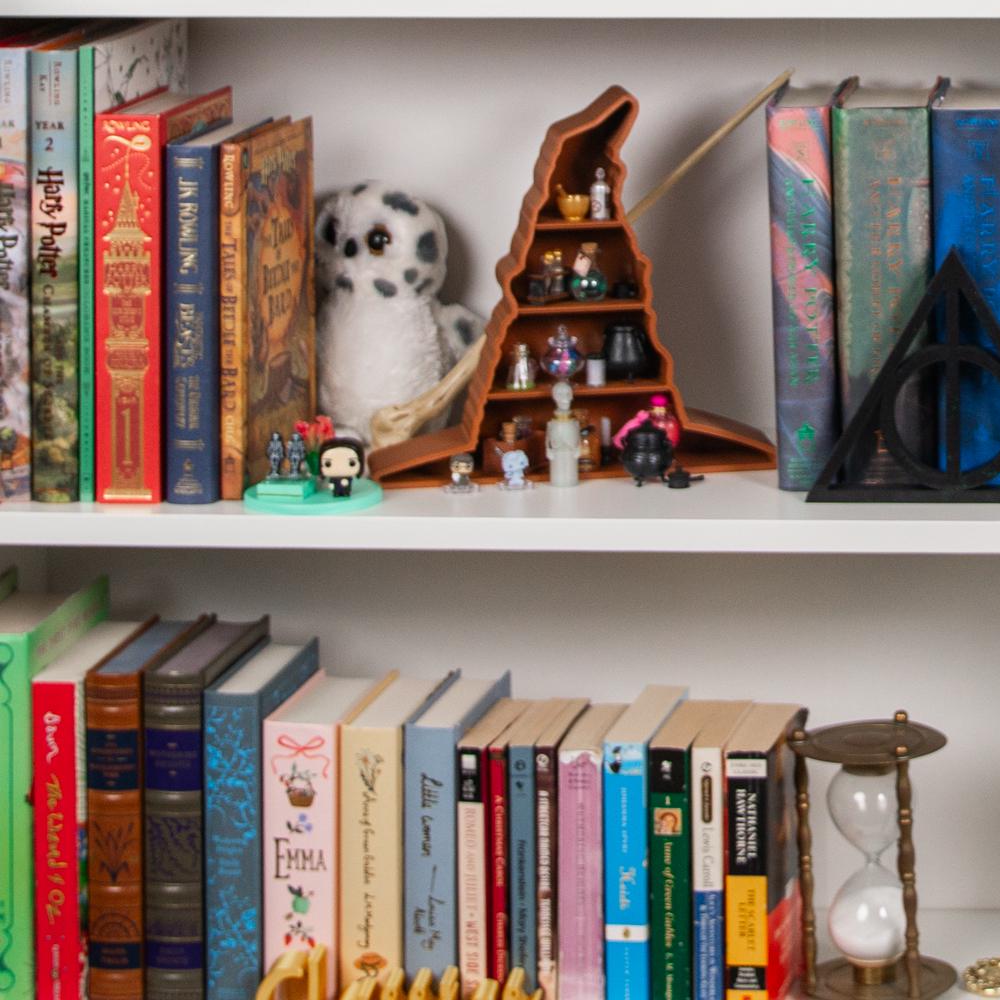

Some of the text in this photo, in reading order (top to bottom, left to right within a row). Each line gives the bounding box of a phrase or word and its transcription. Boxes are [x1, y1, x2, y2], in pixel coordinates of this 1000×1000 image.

[36, 121, 64, 131] YEAR
[223, 153, 237, 209] ROWLING
[36, 167, 67, 280] Harry Potter
[180, 201, 199, 274] ROWLING
[801, 178, 819, 275] HARRY
[887, 176, 904, 276] HARRY
[222, 241, 238, 411] TALES BEEDLE BARD
[420, 771, 444, 857] Little Women
[735, 788, 747, 865] HAWTHORNE
[746, 791, 759, 860] NATHANIEL
[273, 836, 328, 880] EMMA
[618, 866, 637, 911] Heidi
[702, 827, 715, 888] Lewis Carroll
[46, 888, 67, 926] Oz
[663, 879, 676, 949] Green Gables
[738, 902, 747, 938] LETTER
[746, 889, 757, 951] THE SCARLET
[465, 920, 480, 975] WEST SIDE
